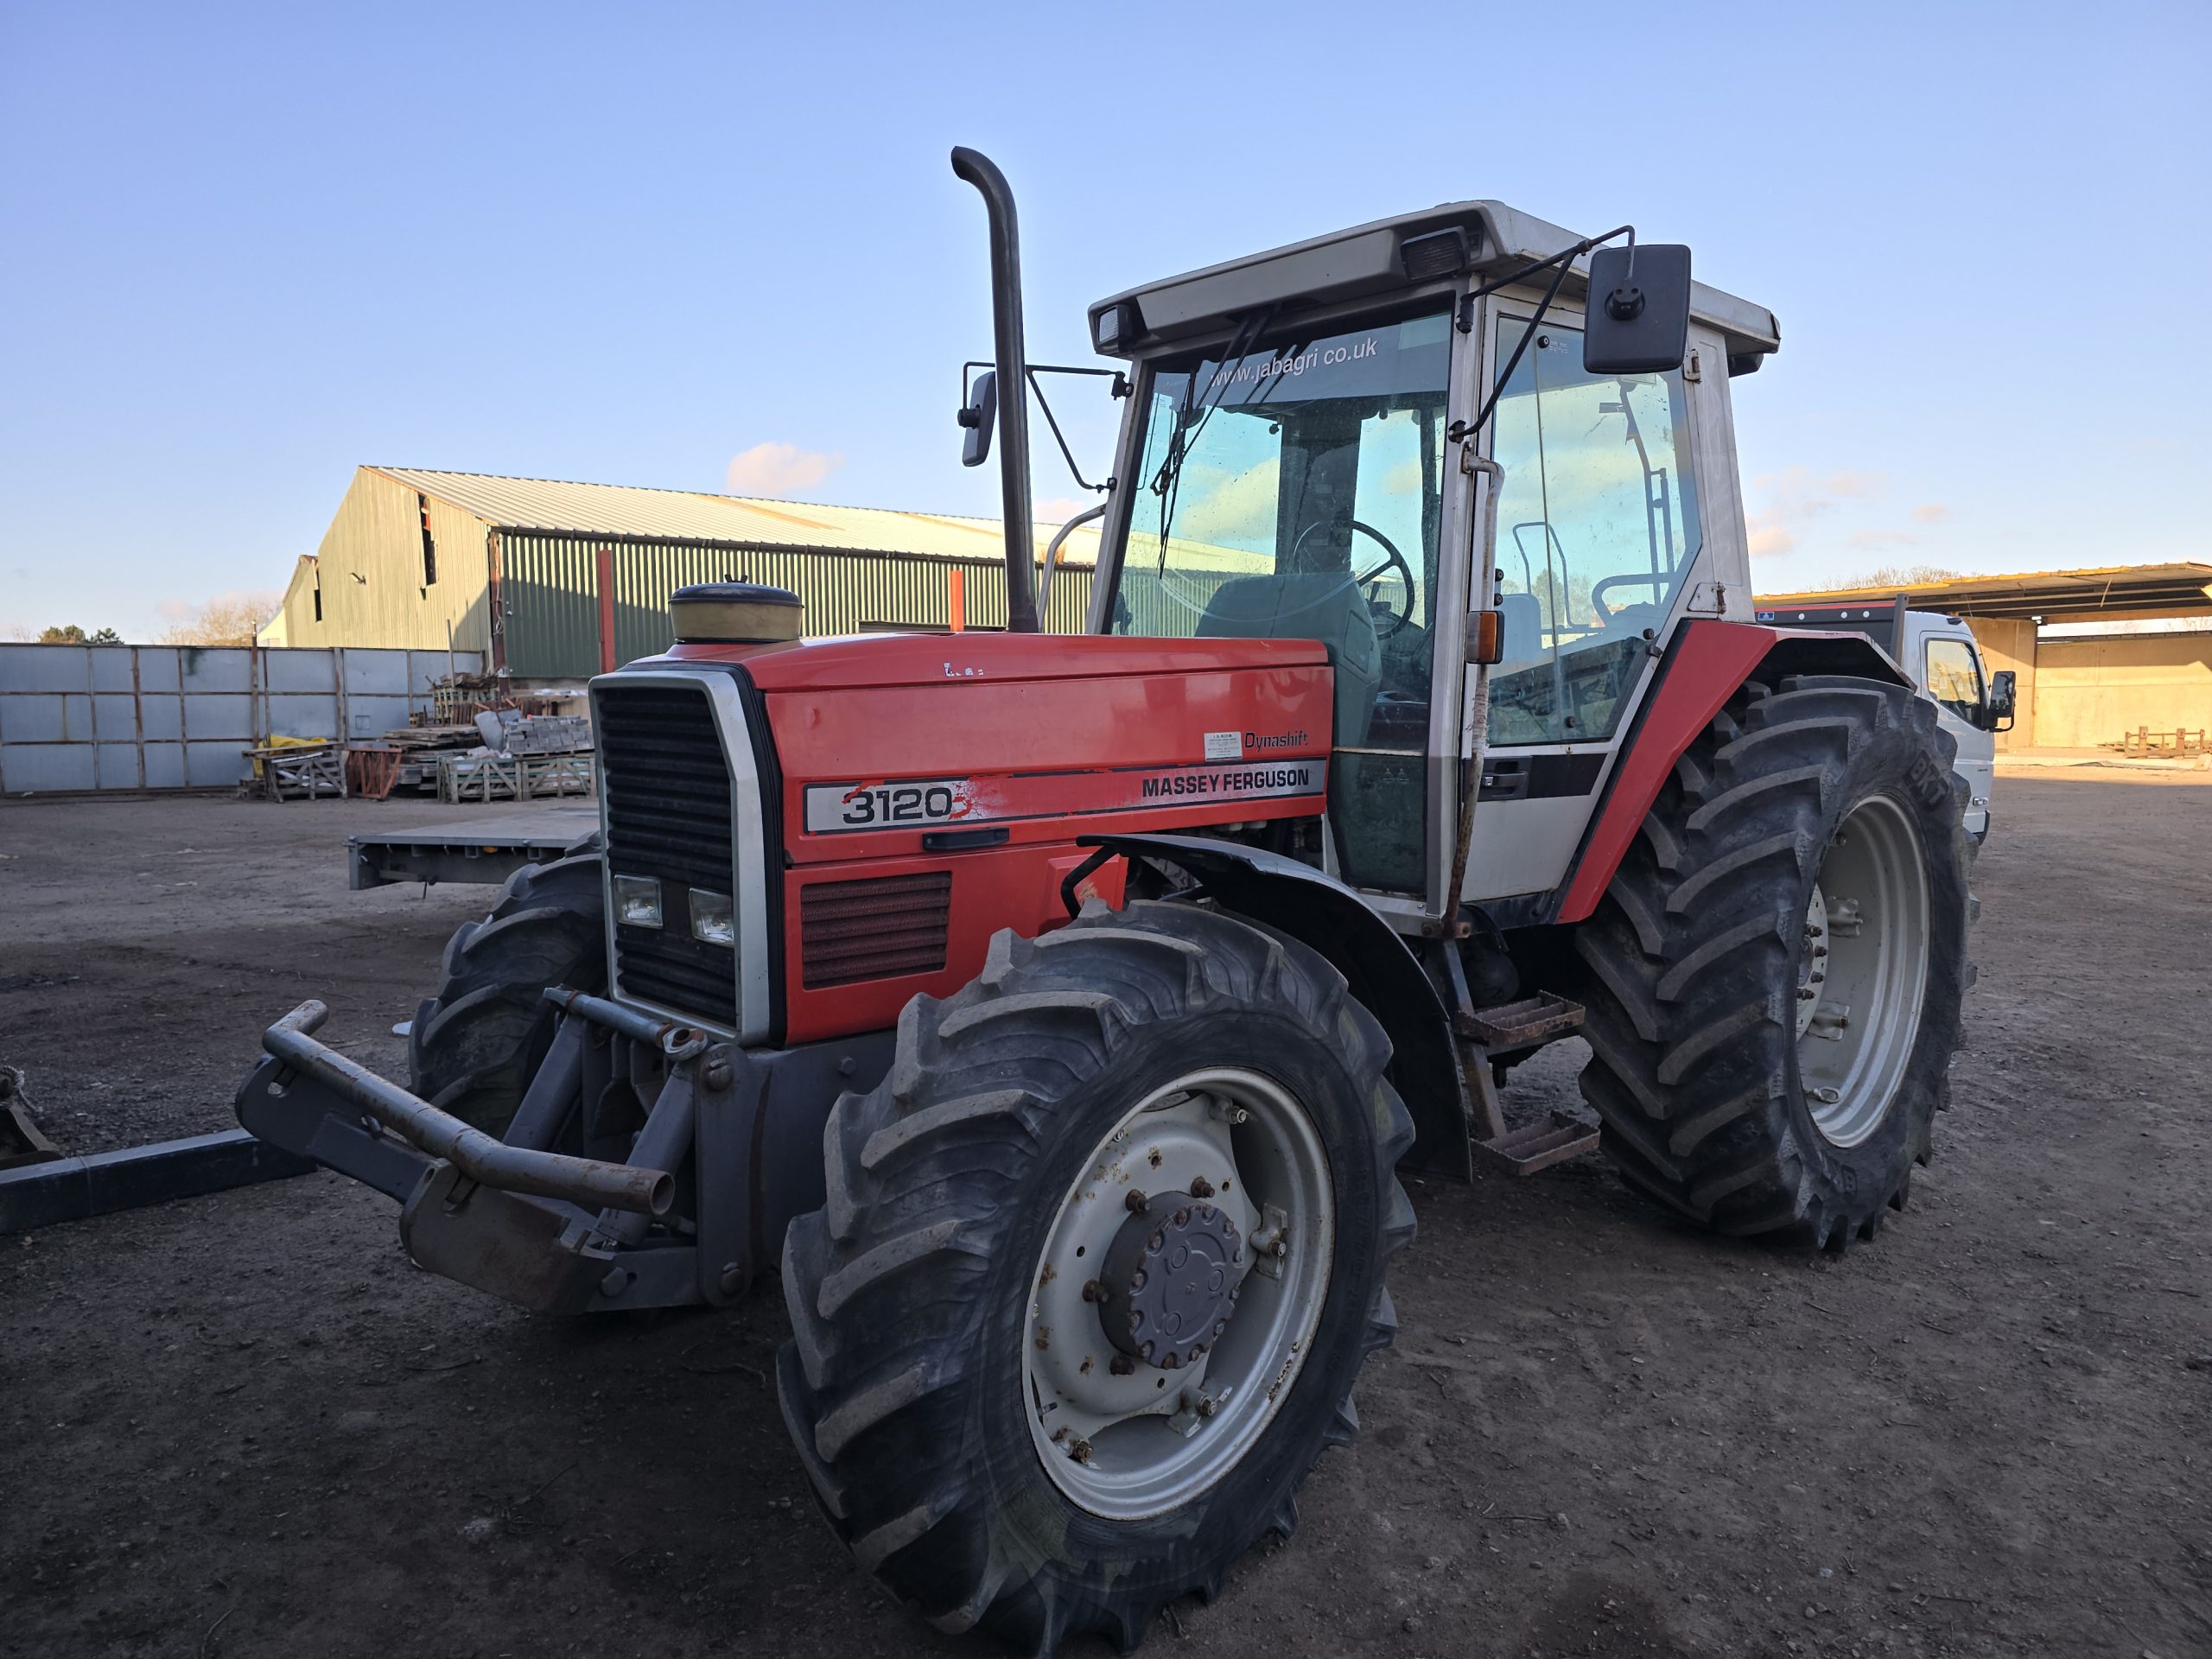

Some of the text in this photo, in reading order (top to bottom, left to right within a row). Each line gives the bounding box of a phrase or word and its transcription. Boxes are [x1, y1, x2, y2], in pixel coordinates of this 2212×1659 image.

[1323, 337, 1379, 365] co.uk
[1244, 730, 1309, 753] Dynashift
[1141, 768, 1309, 798] MASSEY FERGUSON
[1908, 759, 1948, 805] BKT
[842, 786, 953, 824] 3120
